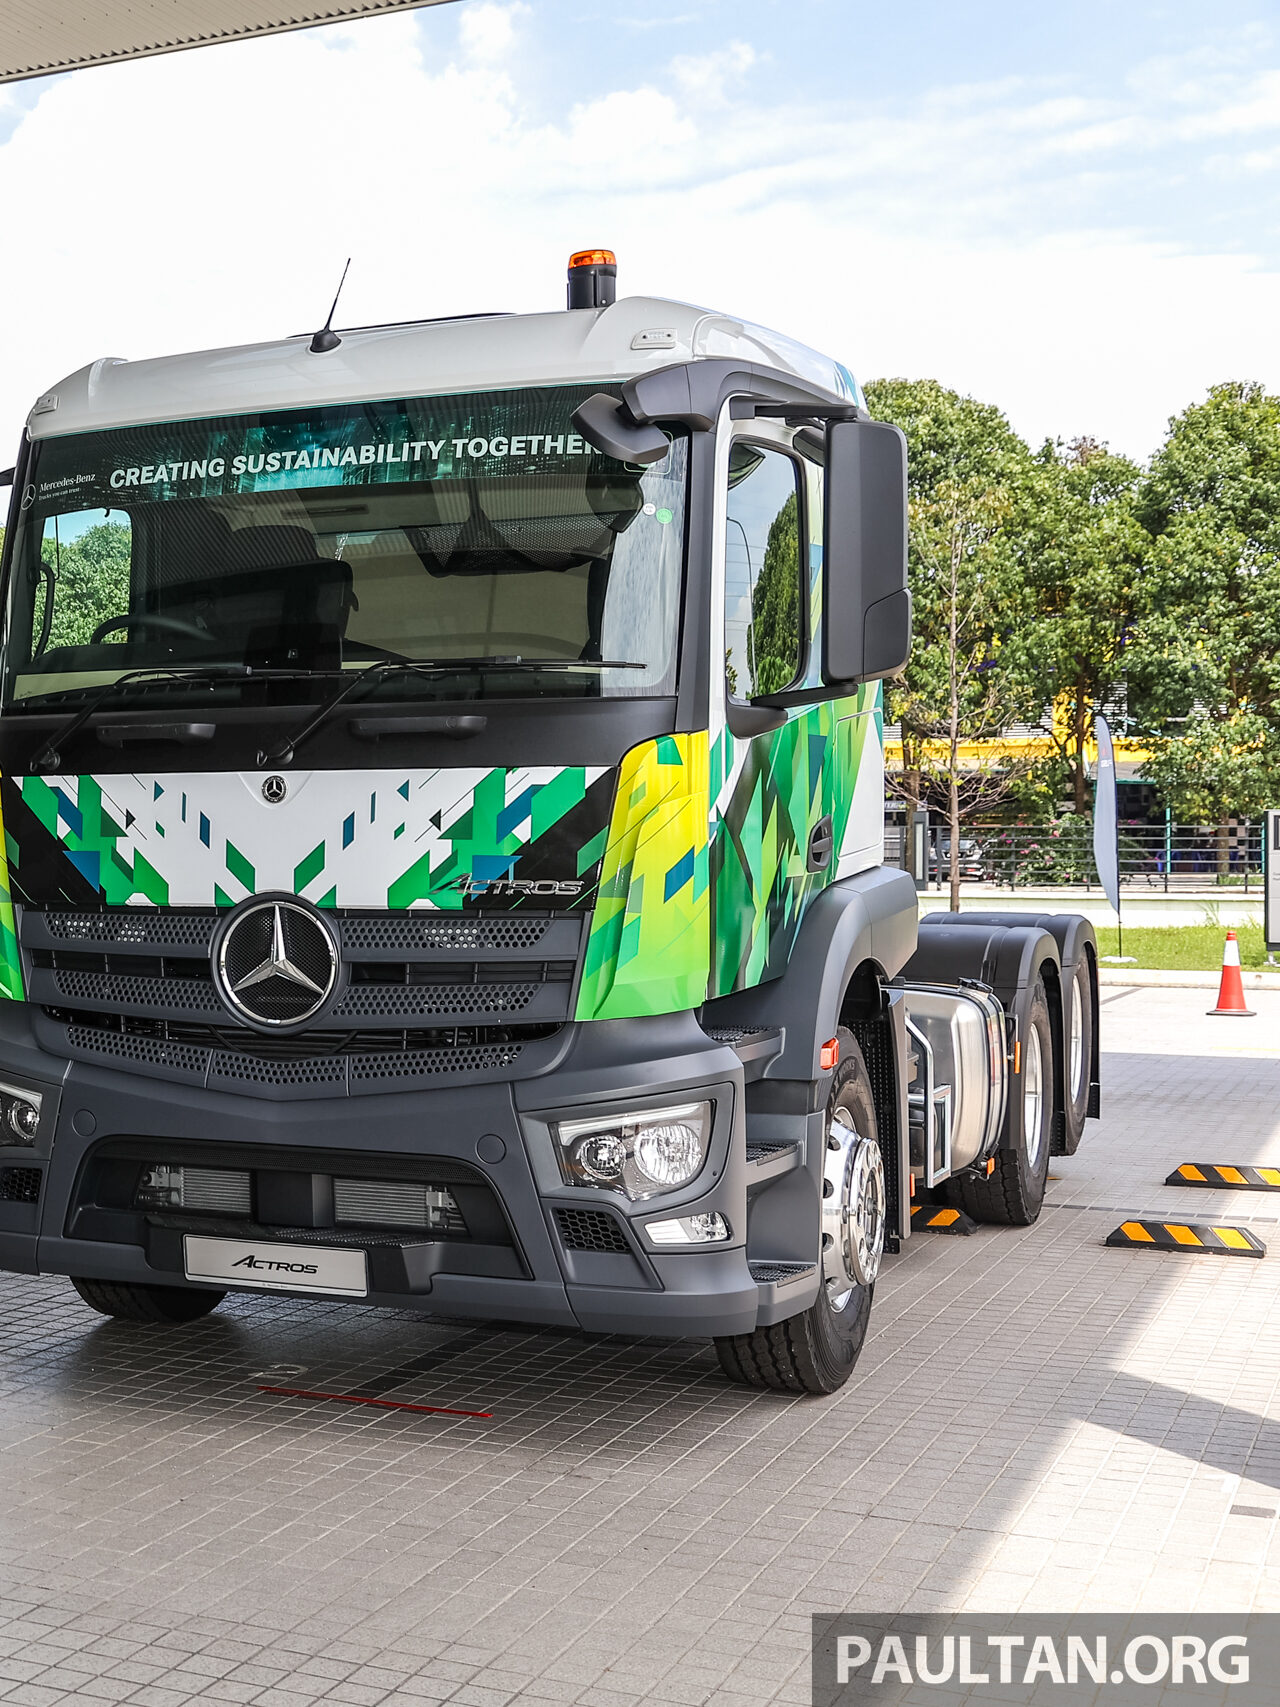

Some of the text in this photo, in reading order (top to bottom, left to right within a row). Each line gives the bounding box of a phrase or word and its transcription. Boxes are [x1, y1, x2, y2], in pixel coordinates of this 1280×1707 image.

[109, 457, 225, 488] CREATING
[231, 439, 446, 475] SUSTAINABILITY
[39, 473, 96, 493] Mercedes-Benz
[428, 872, 585, 896] ACTROS
[231, 1254, 319, 1274] ACTROS
